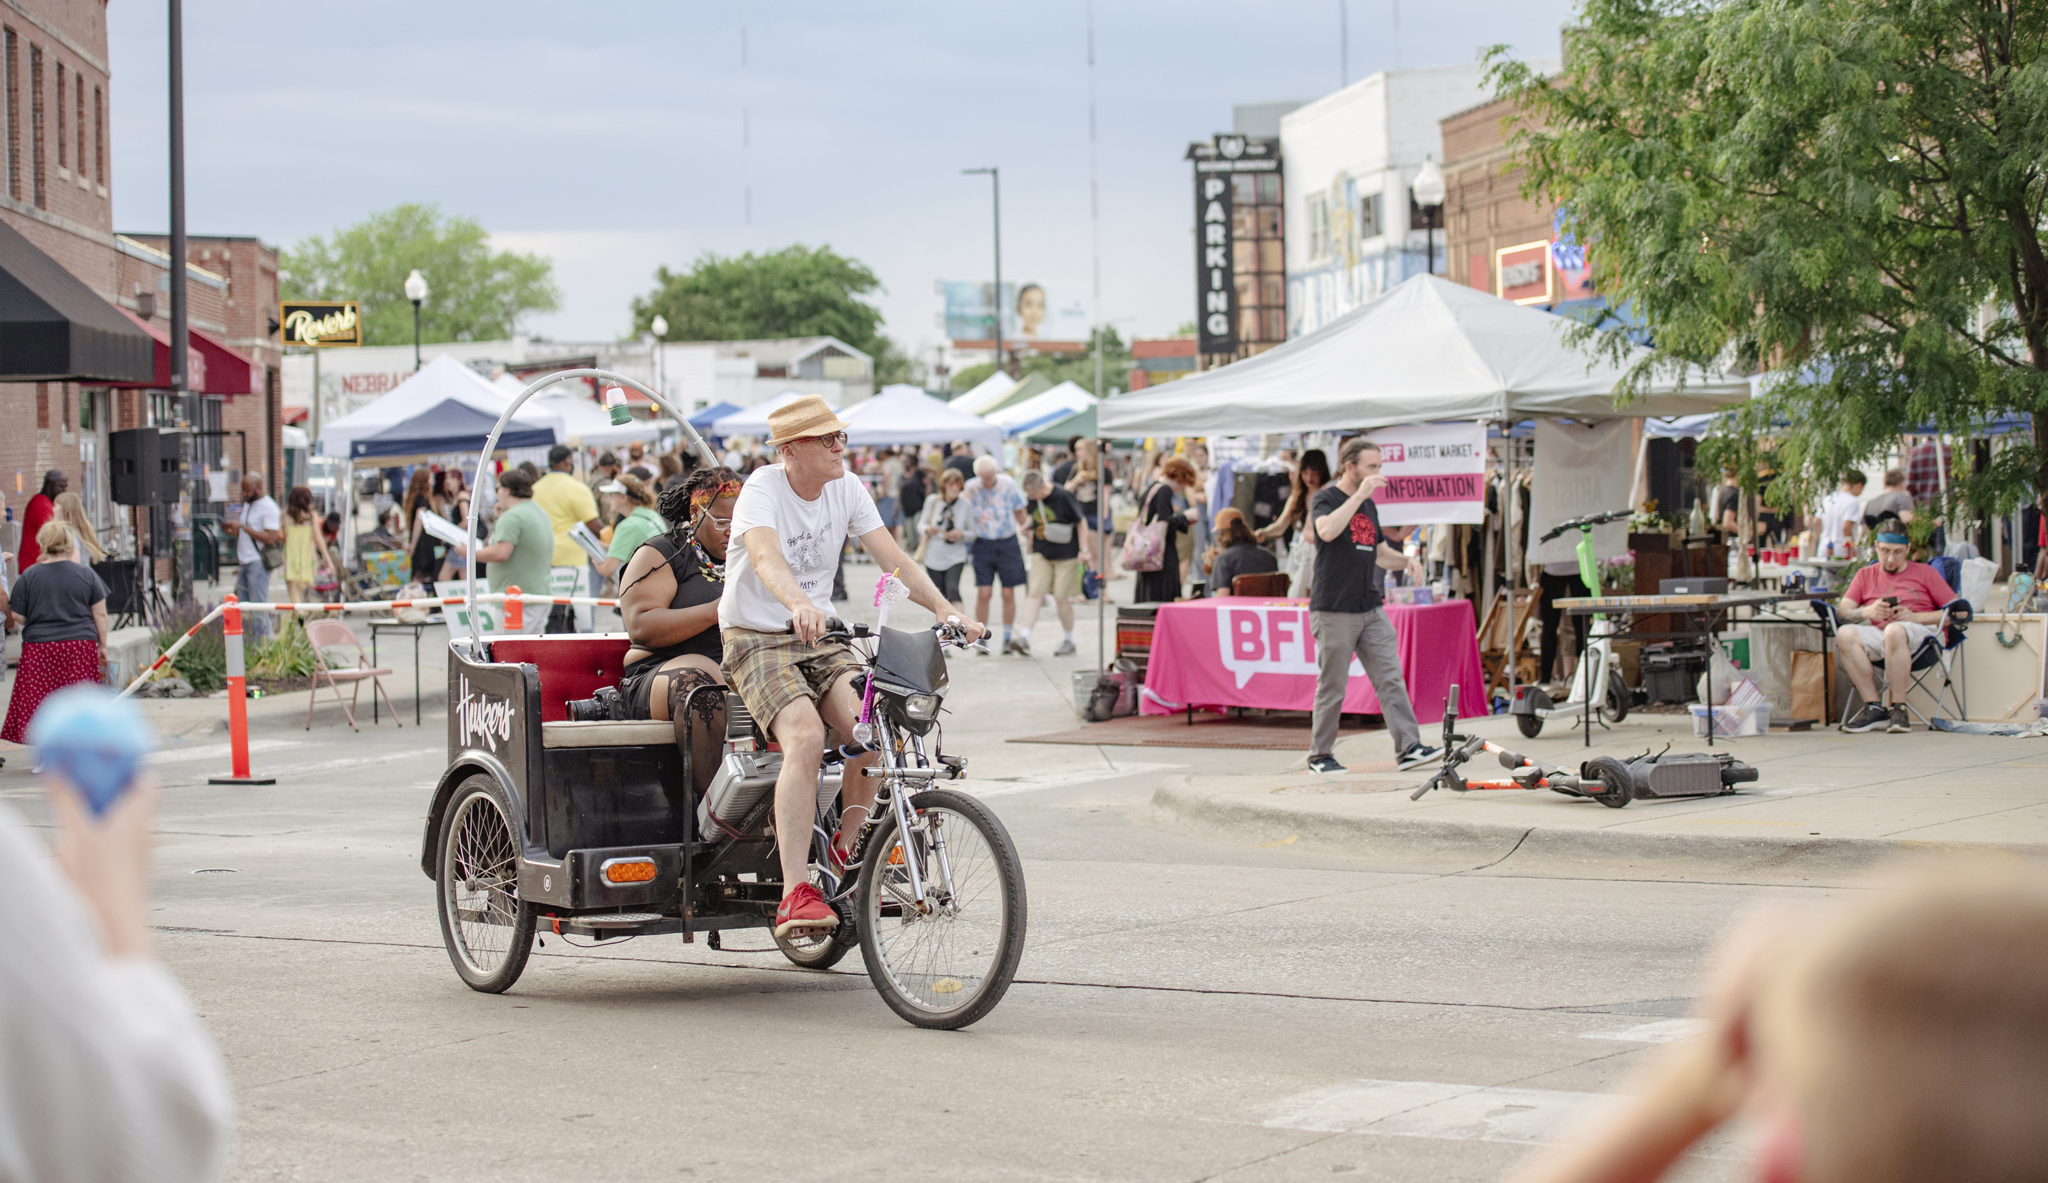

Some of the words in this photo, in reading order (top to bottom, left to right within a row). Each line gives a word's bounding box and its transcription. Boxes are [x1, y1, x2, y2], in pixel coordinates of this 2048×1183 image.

[1204, 178, 1230, 335] PARKING
[286, 304, 357, 346] Reverb
[1408, 446, 1436, 459] ARTIST
[1384, 477, 1476, 499] INFORMATION
[456, 673, 515, 753] Huskers
